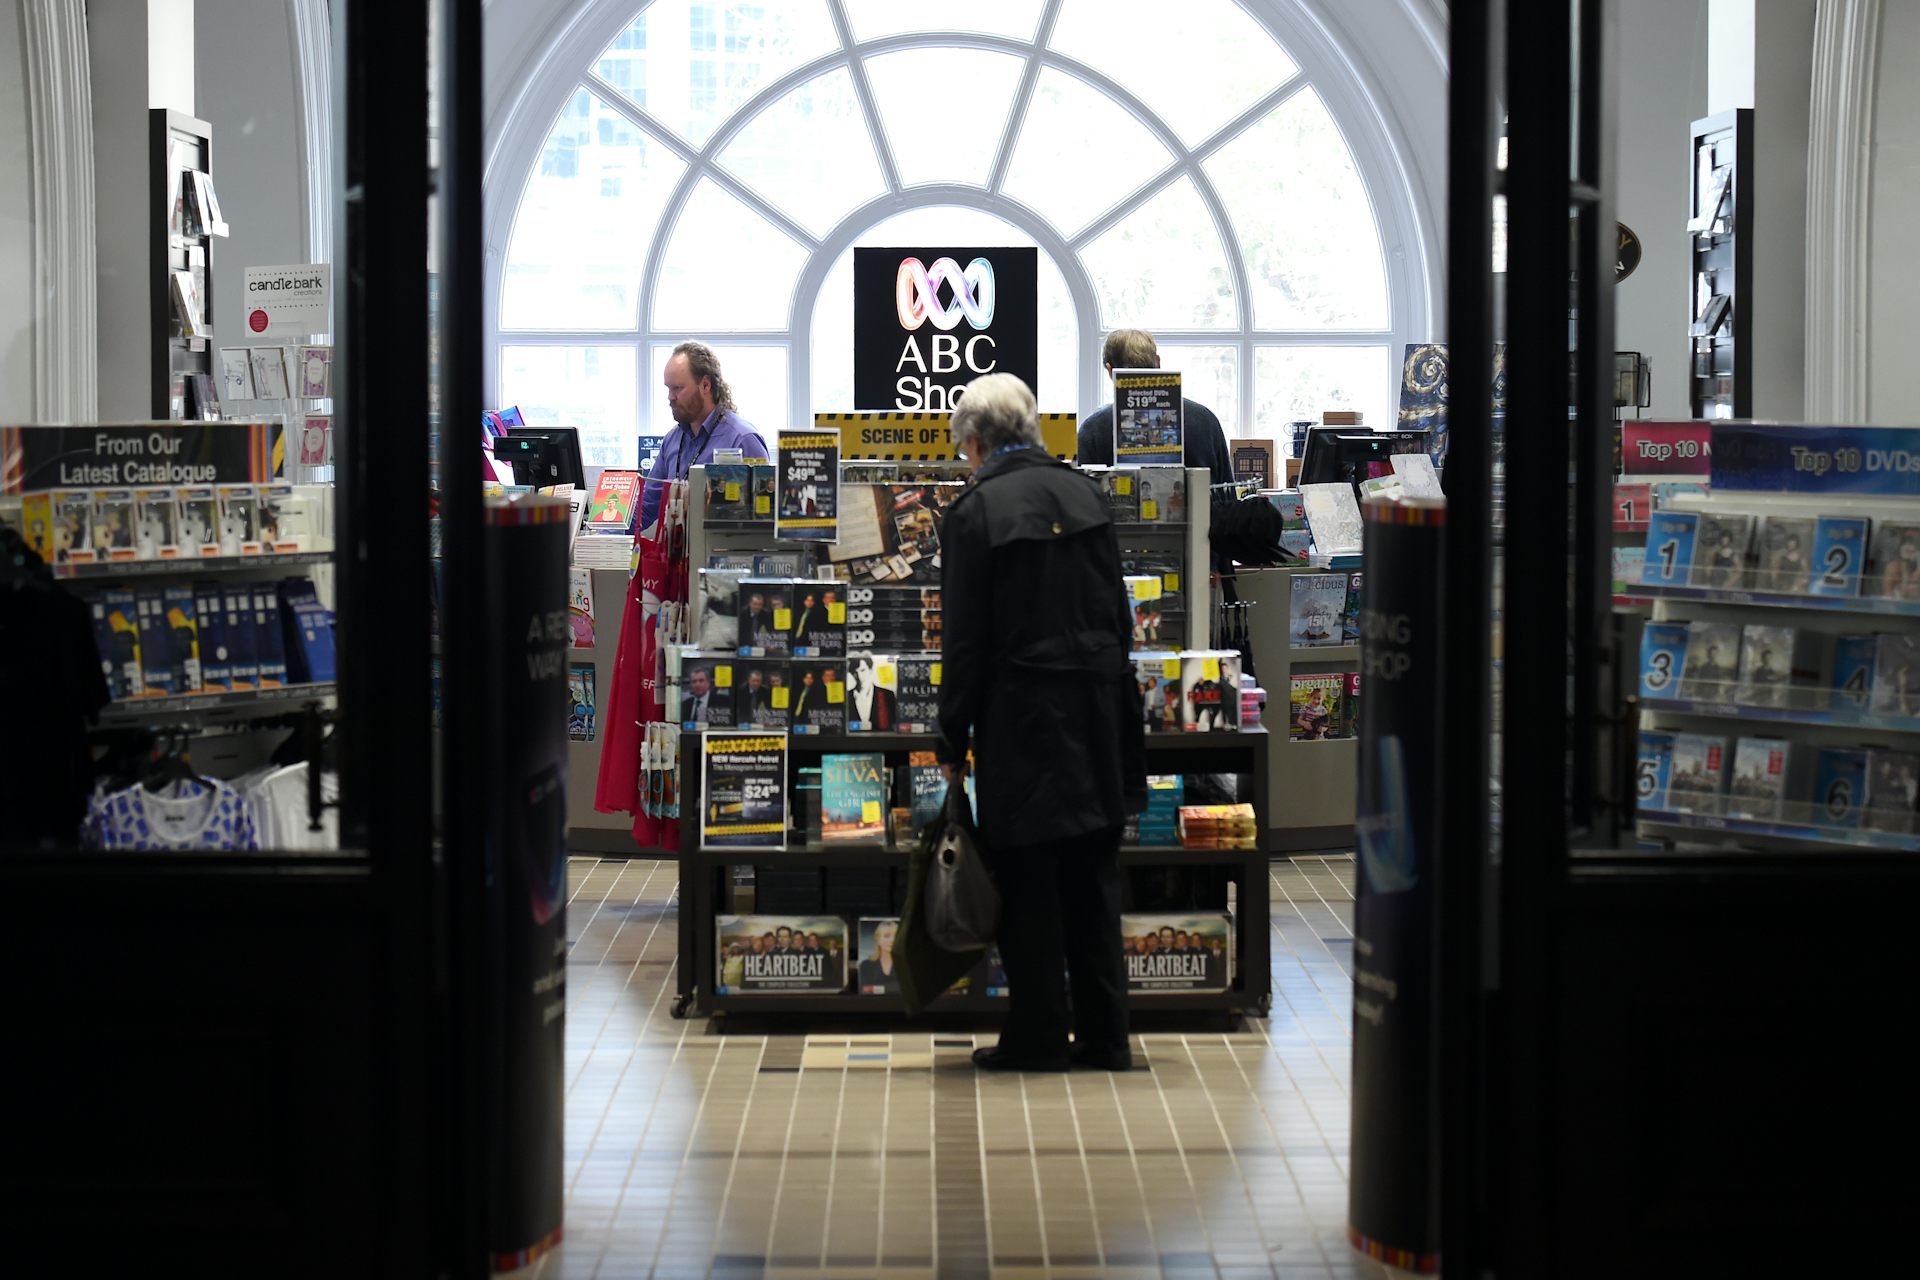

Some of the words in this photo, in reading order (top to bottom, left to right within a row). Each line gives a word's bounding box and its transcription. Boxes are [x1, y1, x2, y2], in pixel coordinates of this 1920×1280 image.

[896, 334, 997, 374] ABC
[895, 375, 967, 411] Sho
[95, 435, 143, 455] From
[148, 433, 182, 454] Our
[861, 428, 914, 444] SCENE
[919, 428, 940, 444] OF
[790, 451, 814, 459] Selected
[1637, 441, 1672, 461] Top
[1675, 440, 1698, 457] 10
[1791, 447, 1830, 475] Top
[1833, 448, 1862, 471] 10
[1866, 449, 1920, 471] DVDs
[60, 463, 119, 484] Latest
[123, 461, 217, 485] Catalogue
[1620, 500, 1634, 522] 1
[759, 562, 792, 574] HIDING
[1658, 538, 1679, 580] 1
[1823, 544, 1849, 587] 2
[1644, 649, 1675, 691] 3
[902, 686, 938, 694] KILLIN
[1294, 679, 1343, 693] organic
[826, 767, 880, 784] SILVA
[1636, 759, 1660, 801] 5
[1826, 777, 1851, 819] 6
[744, 954, 824, 977] HEARTBEAT
[1128, 954, 1207, 977] HEARTBEAT
